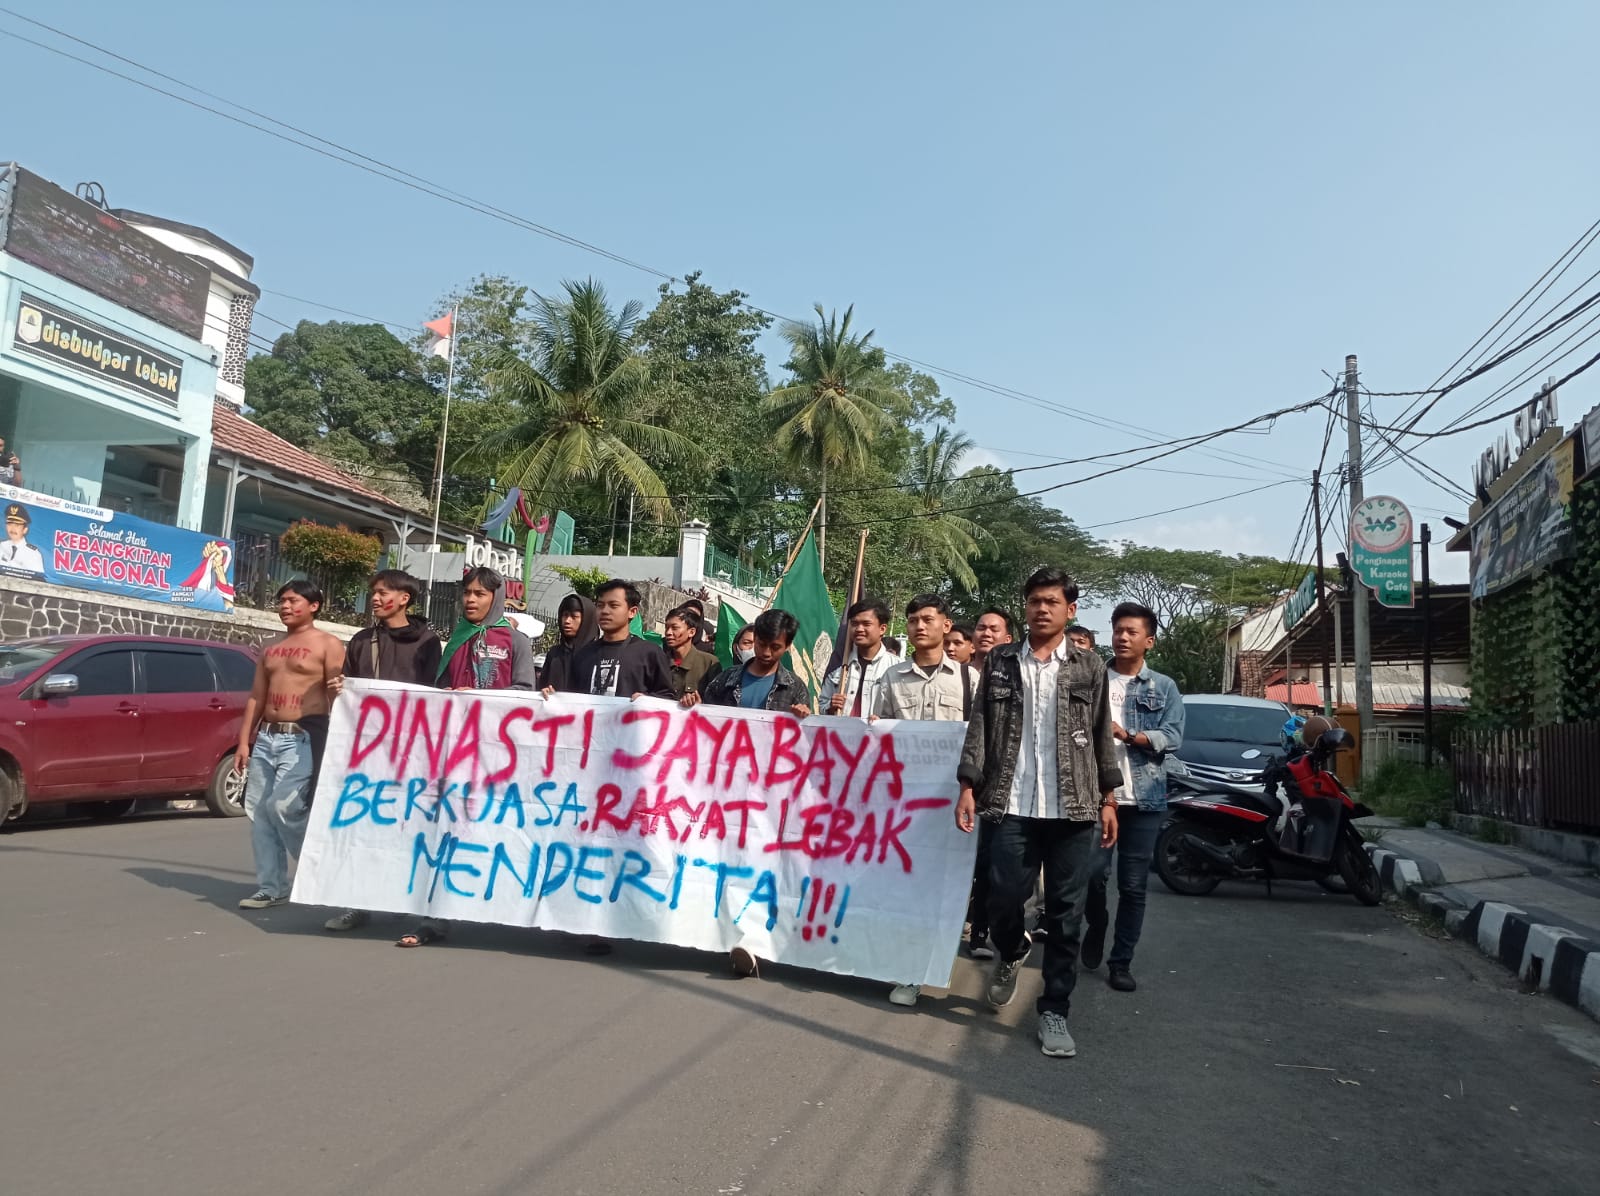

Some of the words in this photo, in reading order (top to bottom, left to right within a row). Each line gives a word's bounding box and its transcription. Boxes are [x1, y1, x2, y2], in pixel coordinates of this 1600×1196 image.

[42, 320, 131, 371] disbudpar
[135, 356, 178, 392] lebak
[65, 503, 104, 517] DISBUDPAR
[87, 523, 124, 541] Selamat
[126, 531, 147, 547] Hari
[55, 530, 171, 568] KEBANGKITAN
[1356, 555, 1408, 566] Penginapan
[54, 548, 171, 590] NASIONAL
[1370, 568, 1408, 578] Karaoke
[1385, 580, 1408, 591] Café
[348, 690, 594, 784] DINASTI
